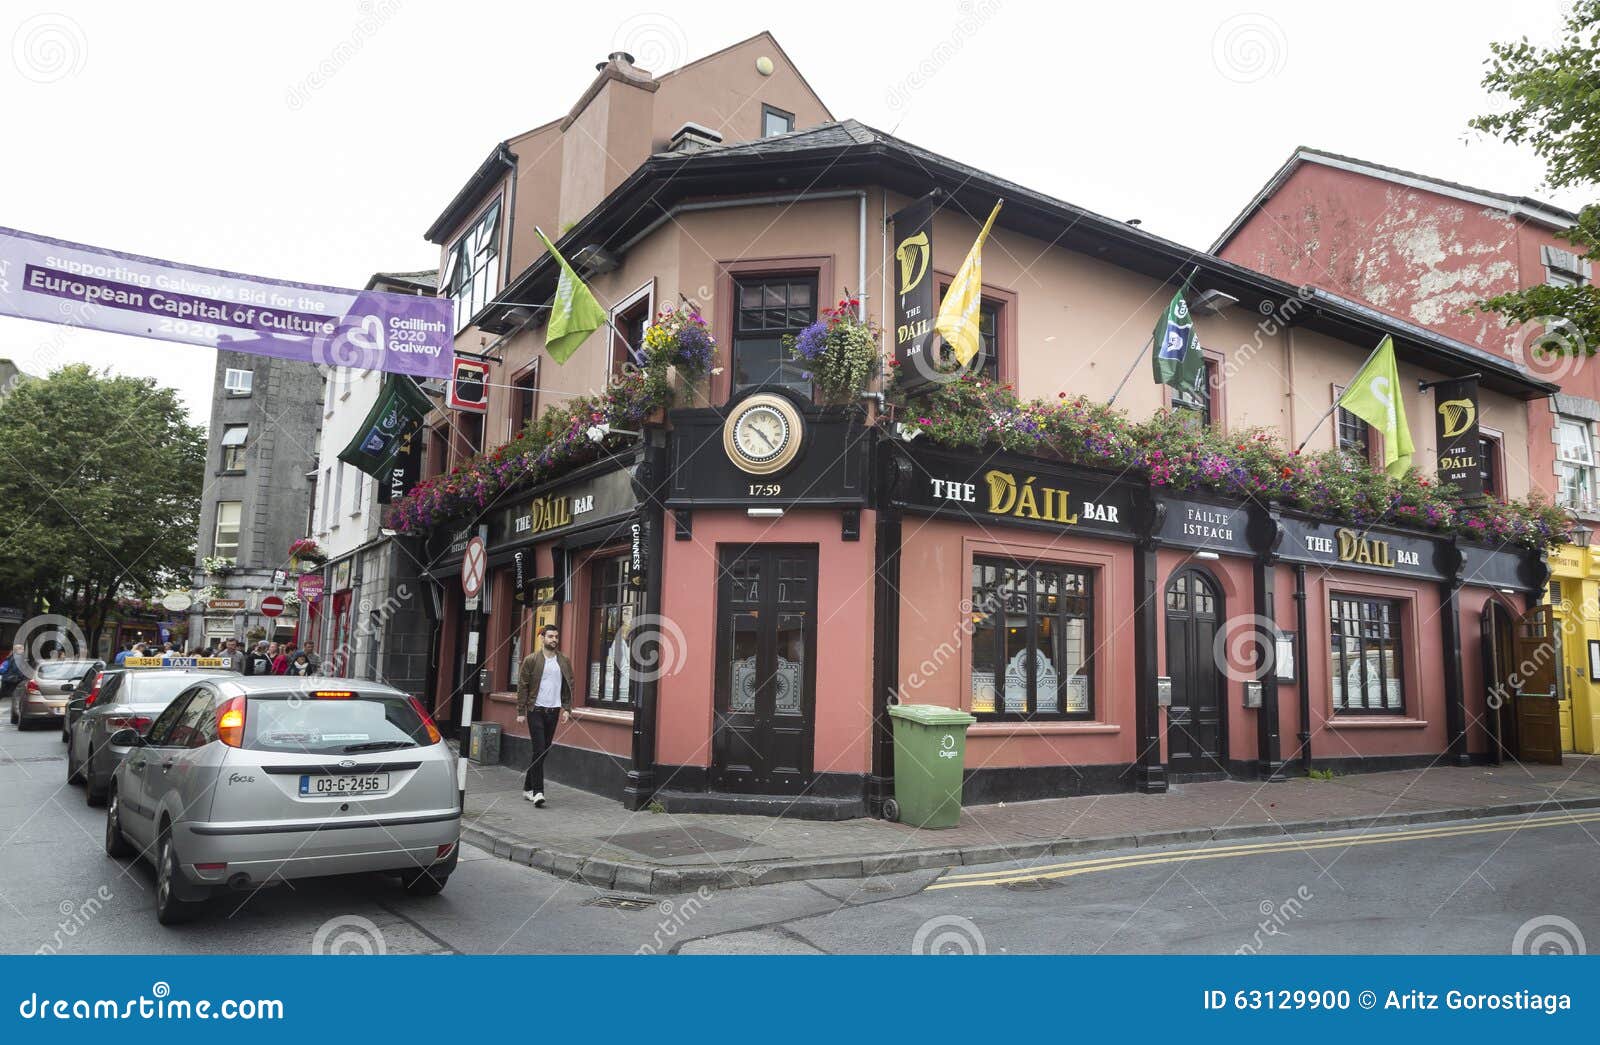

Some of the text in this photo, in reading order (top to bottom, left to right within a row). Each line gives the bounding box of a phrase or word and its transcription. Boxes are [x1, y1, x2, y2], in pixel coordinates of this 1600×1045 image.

[45, 255, 326, 312] supporting Galway's Bid for the
[30, 269, 335, 335] European Capital of Culture
[906, 306, 921, 319] THE
[158, 319, 219, 339] 2020
[389, 316, 446, 333] Gaillimh
[389, 328, 427, 342] 2020
[389, 340, 442, 358] Galway
[906, 343, 921, 357] BAR
[1450, 446, 1467, 455] THE
[391, 468, 405, 498] BAR
[1451, 472, 1467, 480] BAR
[748, 484, 781, 496] 17:59
[930, 469, 1120, 525] THE DÁIL BAR
[515, 493, 594, 534] THE DÁIL BAR
[1187, 508, 1230, 526] FÁILTE
[1183, 523, 1234, 541] ISTEACH
[631, 524, 641, 571] GUINNESS
[1305, 535, 1334, 554] THE
[1396, 550, 1420, 566] BAR
[168, 658, 192, 667] TAXI
[316, 777, 379, 792] 03-G-2456
